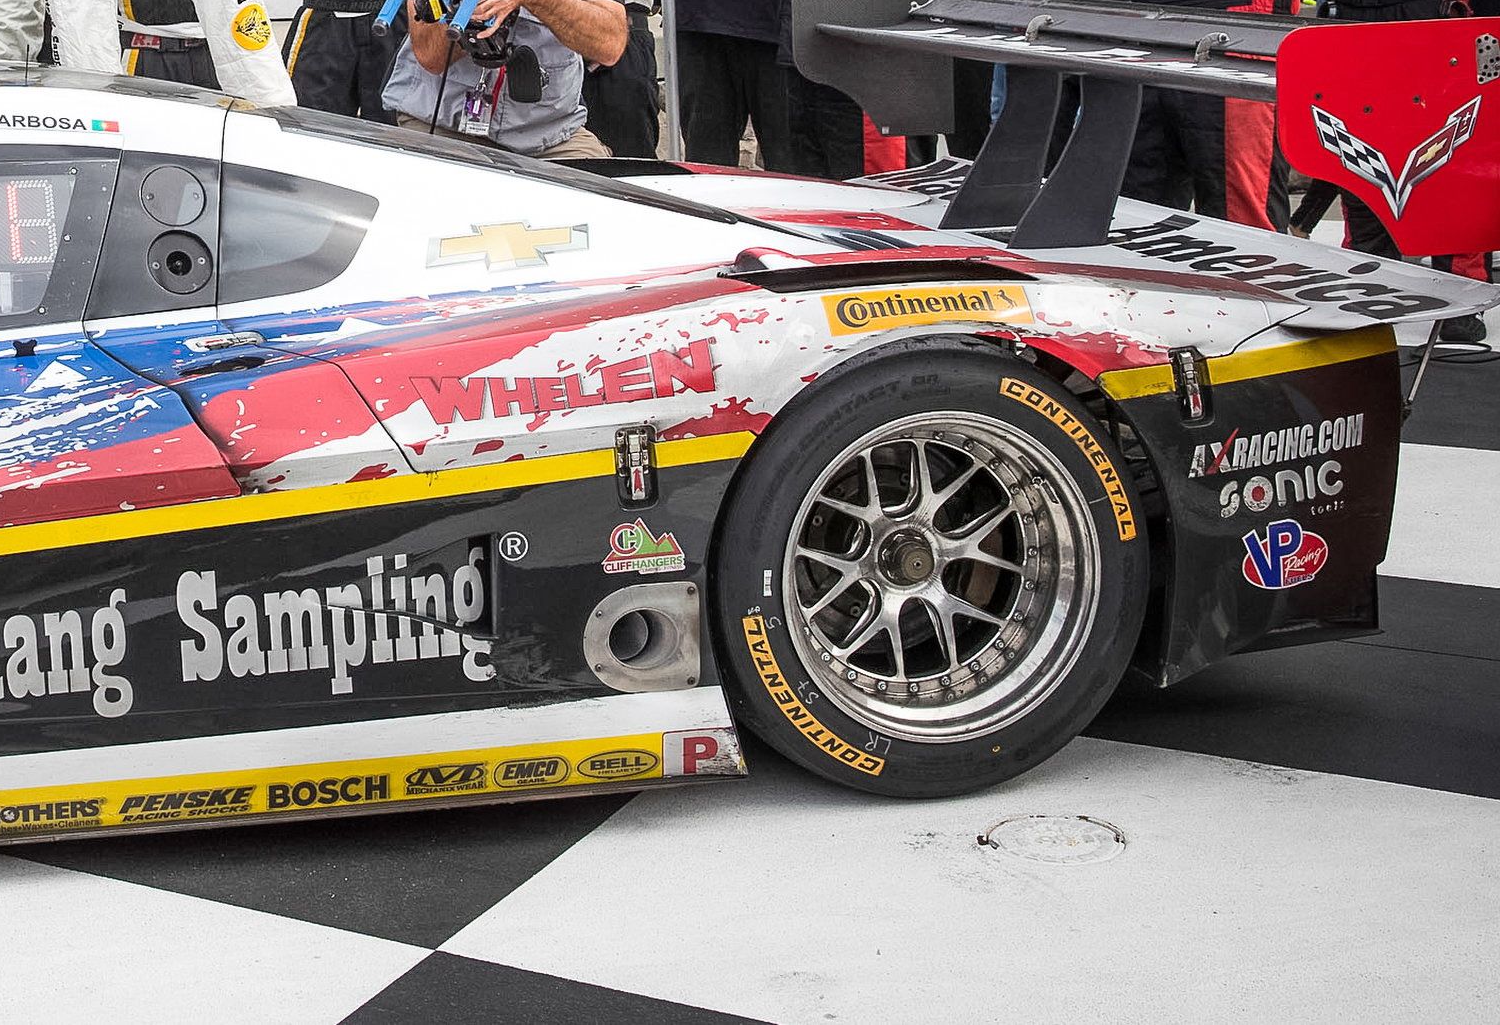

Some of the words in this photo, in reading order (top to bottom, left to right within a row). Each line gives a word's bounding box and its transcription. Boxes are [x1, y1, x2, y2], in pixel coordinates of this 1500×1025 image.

[836, 287, 996, 327] Continental
[409, 337, 717, 425] WHELEN
[1004, 379, 1135, 537] CONTINENTAL
[1187, 412, 1365, 479] AXRACING.COM
[604, 556, 683, 572] CLIFFHANGERS
[1243, 519, 1303, 589] VP
[1284, 546, 1327, 577] Racing
[175, 546, 497, 694] Sampling
[745, 619, 882, 773] CONTINENTAL
[503, 761, 558, 781] EMCO
[590, 755, 649, 772] BELL
[682, 736, 719, 774] P
[118, 785, 257, 815] PENSKE
[267, 773, 389, 811] BOSCH
[406, 784, 458, 796] MECHANIX
[457, 780, 485, 791] WEAR
[121, 810, 182, 823] RACING
[186, 805, 249, 817] SHOCKS
